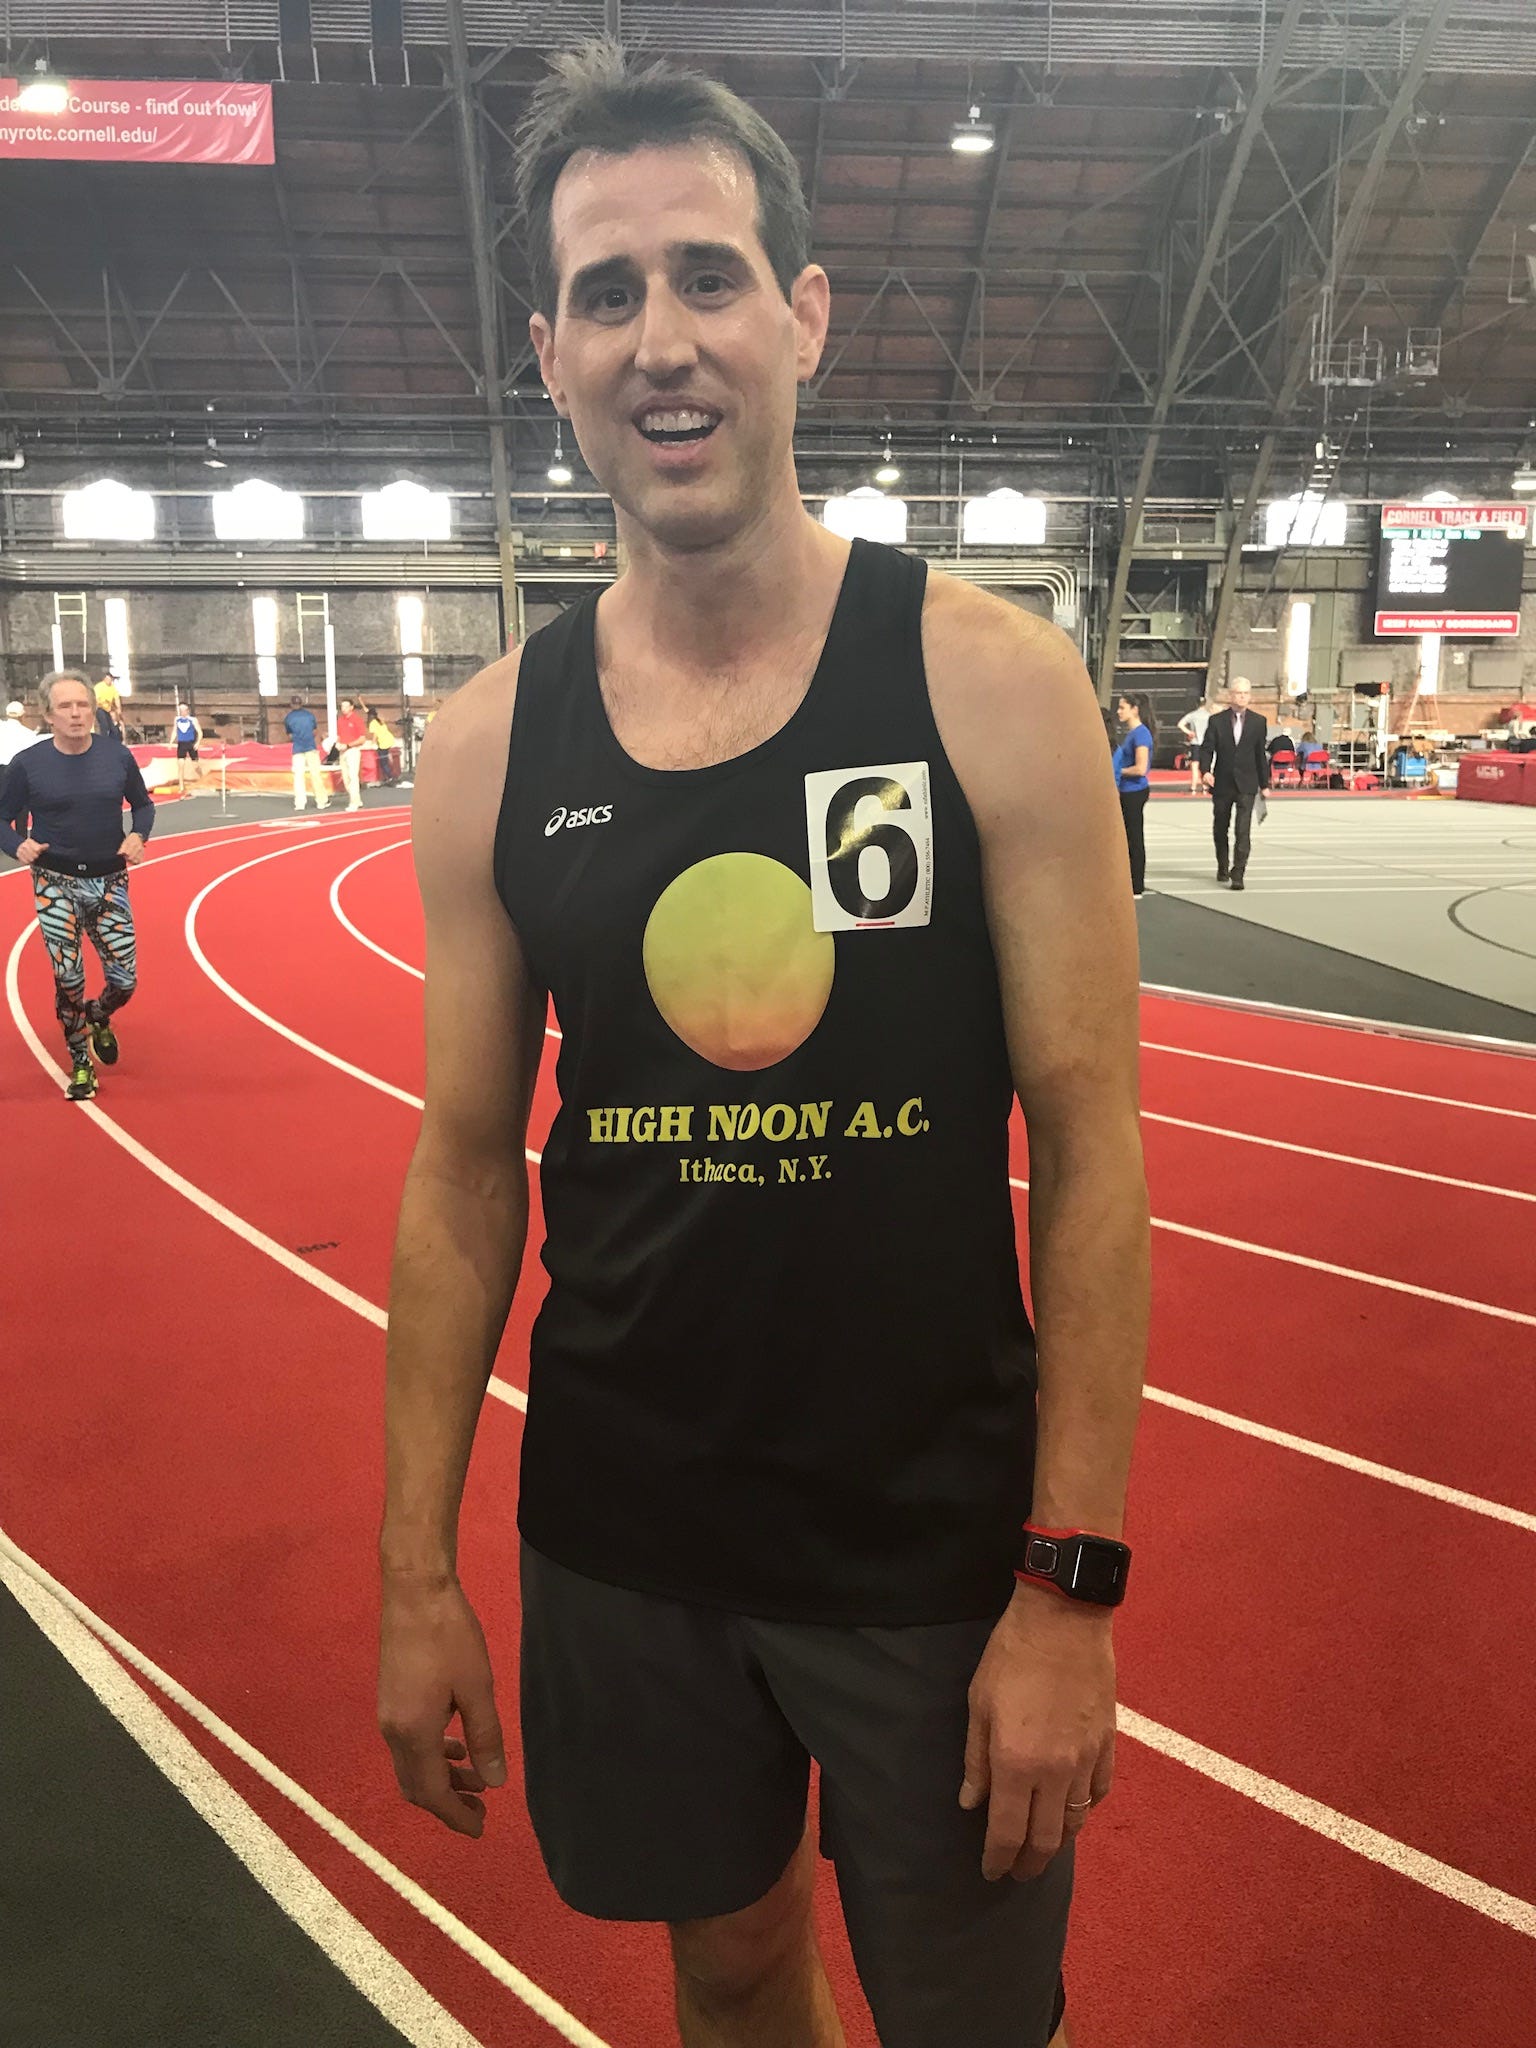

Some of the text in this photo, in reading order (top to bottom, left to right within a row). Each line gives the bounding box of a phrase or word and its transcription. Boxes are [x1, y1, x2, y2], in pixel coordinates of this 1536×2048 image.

[69, 97, 130, 113] Course
[146, 98, 179, 115] find
[184, 100, 211, 116] out
[1387, 510, 1437, 524] CORNELL
[1441, 510, 1477, 524] TRACK
[1491, 511, 1523, 525] FIELD
[566, 804, 613, 829] asics
[825, 777, 918, 919] 6
[586, 1096, 930, 1143] HIGH NOON A.C.
[679, 1154, 832, 1187] Ithaca, N.Y.
